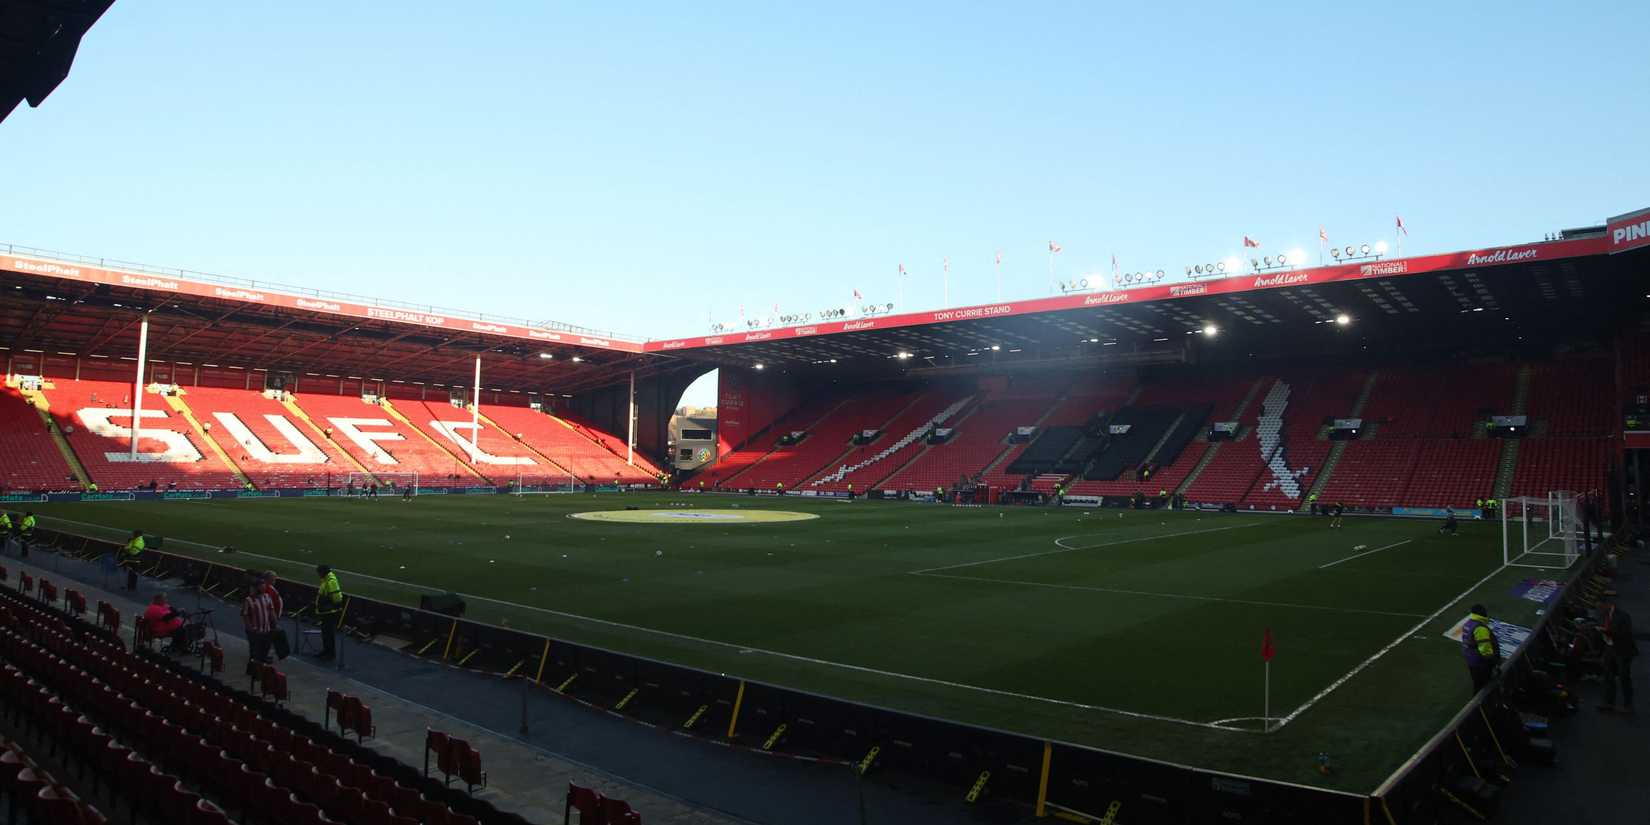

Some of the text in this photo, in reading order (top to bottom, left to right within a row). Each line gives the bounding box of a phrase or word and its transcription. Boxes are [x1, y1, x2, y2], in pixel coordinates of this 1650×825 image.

[1467, 249, 1537, 265] Arnold Laver
[15, 261, 80, 277] SteelPhalt
[1373, 267, 1402, 275] TIMBER
[123, 275, 178, 290] SteelPhalt
[1254, 274, 1308, 287] Arnold Laver
[215, 287, 264, 301] SteelPhalt
[367, 308, 444, 326] STEELPHALT KOP
[934, 305, 1011, 321] TONY CURRIE STAND
[77, 407, 538, 464] SUFC
